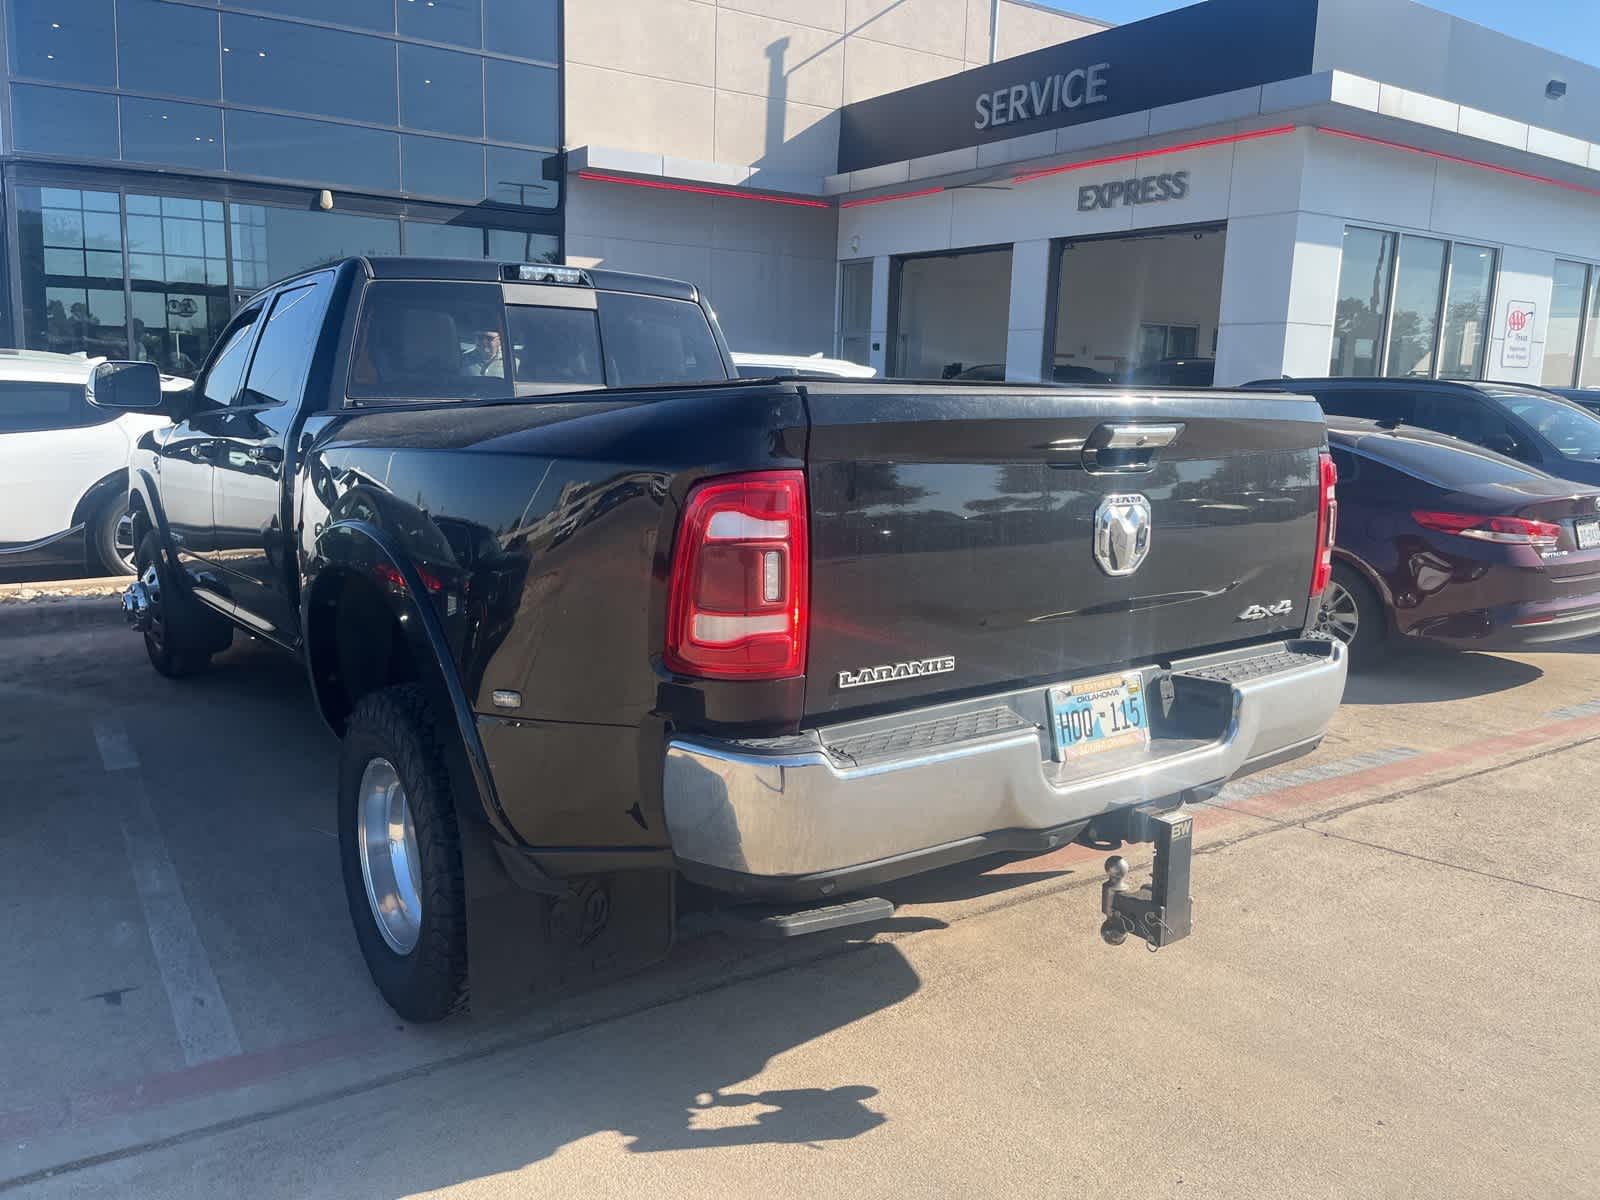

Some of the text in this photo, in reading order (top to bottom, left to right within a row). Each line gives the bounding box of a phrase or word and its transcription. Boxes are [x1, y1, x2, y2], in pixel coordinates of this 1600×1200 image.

[974, 62, 1110, 130] SERVICE
[1077, 171, 1190, 211] EXPRESS
[839, 655, 955, 689] LARAMIE
[1076, 688, 1120, 703] OKLAHOMA
